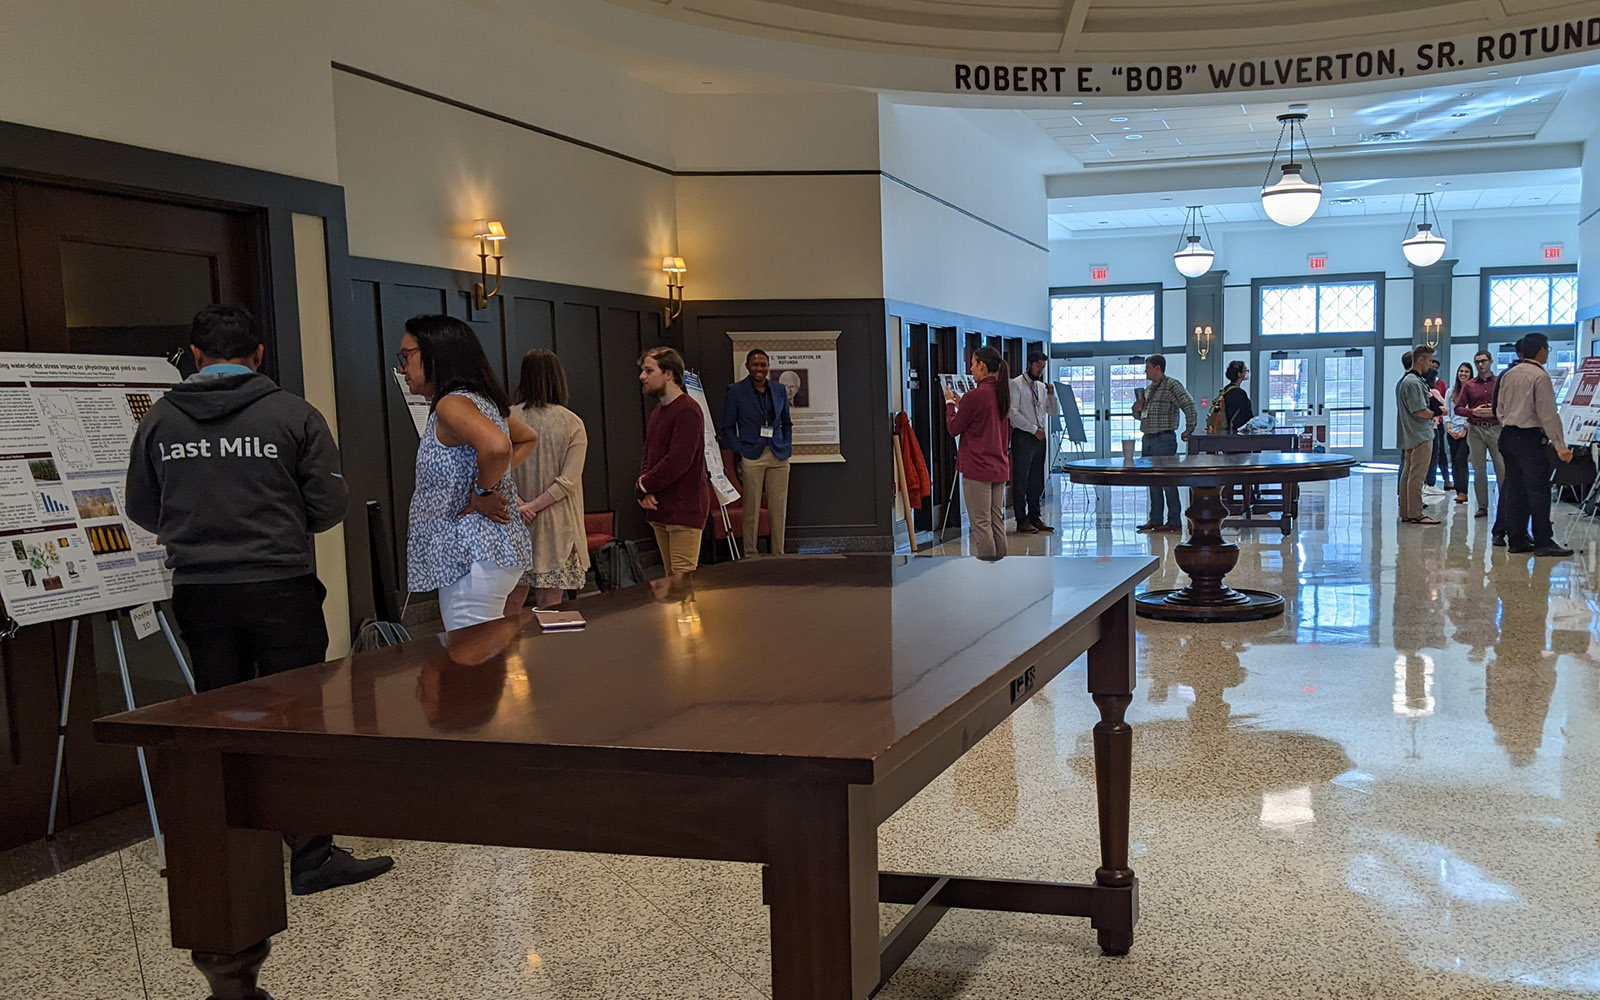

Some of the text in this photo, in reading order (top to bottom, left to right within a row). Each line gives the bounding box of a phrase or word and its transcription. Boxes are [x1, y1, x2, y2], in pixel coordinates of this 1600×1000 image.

[955, 64, 1066, 92] ROBERT
[1077, 67, 1101, 92] E.
[1207, 48, 1405, 89] WOLVERTON,
[1416, 41, 1464, 71] SR.
[1545, 247, 1560, 258] EXIT
[158, 436, 279, 461] Last Mile
[134, 609, 153, 621] Poster
